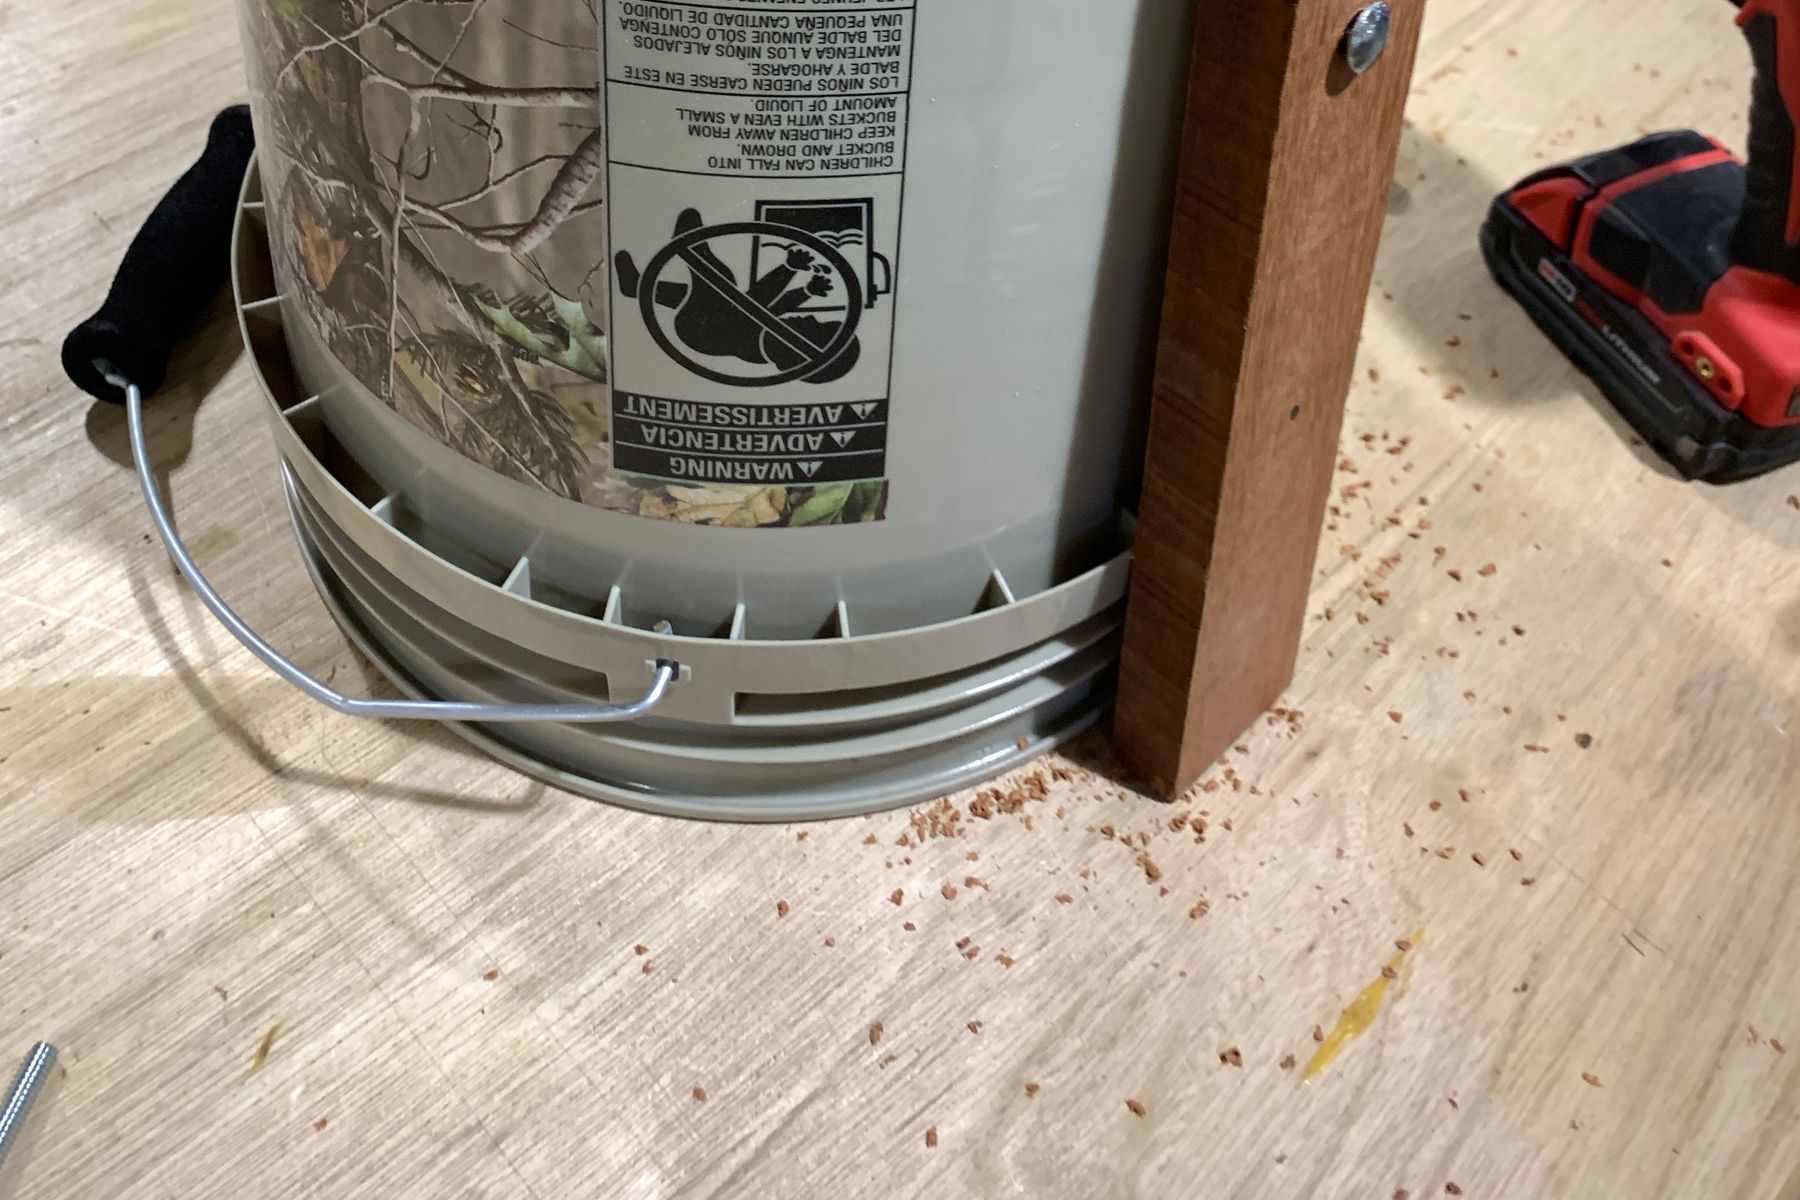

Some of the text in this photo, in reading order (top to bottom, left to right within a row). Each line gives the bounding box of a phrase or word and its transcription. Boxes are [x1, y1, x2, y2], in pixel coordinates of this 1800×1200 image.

[619, 2, 903, 31] UNA PEQUEÑA CANTIDAD DE LIQUÍDO.
[620, 17, 901, 45] DEL BALDE AUNQUE SÓLO CONTENGA
[633, 36, 901, 60] MANTENGA A LOS NIÑOS ALEJADOS
[624, 66, 898, 92] LOS NIÑOS PUEDEN CAERSE EN ESTE
[748, 62, 899, 75] BALDE Y AHOGARSE.
[751, 98, 897, 111] AMOUNT OF LIQUID.
[676, 109, 896, 125] BUCKETS WITH EVEN A SMALL
[689, 125, 895, 139] KEEP CHILDREN AWAY FROM
[737, 142, 894, 156] BUCKET AND DROWN.
[708, 156, 893, 170] CHILDREN CAN FALL INTO
[623, 395, 843, 425] AVERTISSEMENT
[641, 425, 824, 451] ADVERTENCIA
[669, 457, 792, 478] WARNING
